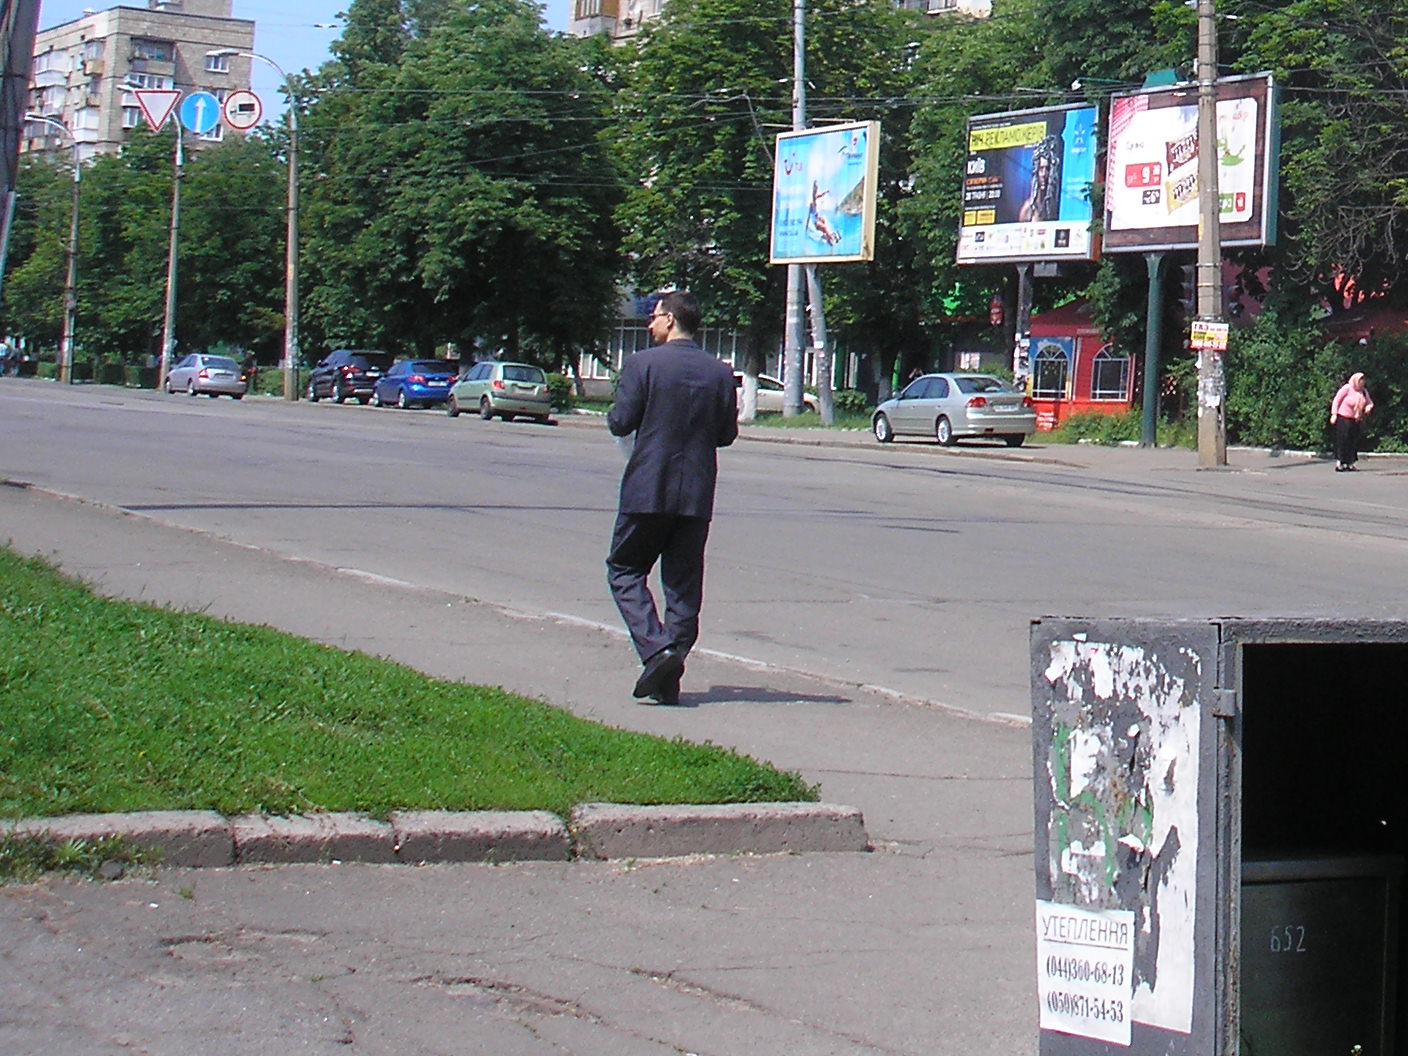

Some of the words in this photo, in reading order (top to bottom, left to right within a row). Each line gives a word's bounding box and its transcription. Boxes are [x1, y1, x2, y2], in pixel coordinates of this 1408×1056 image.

[1041, 914, 1128, 945] УТЕПЛЕННЯ
[1046, 954, 1125, 987] (044)360-68-13
[1047, 990, 1124, 1023] (050)871-54-53
